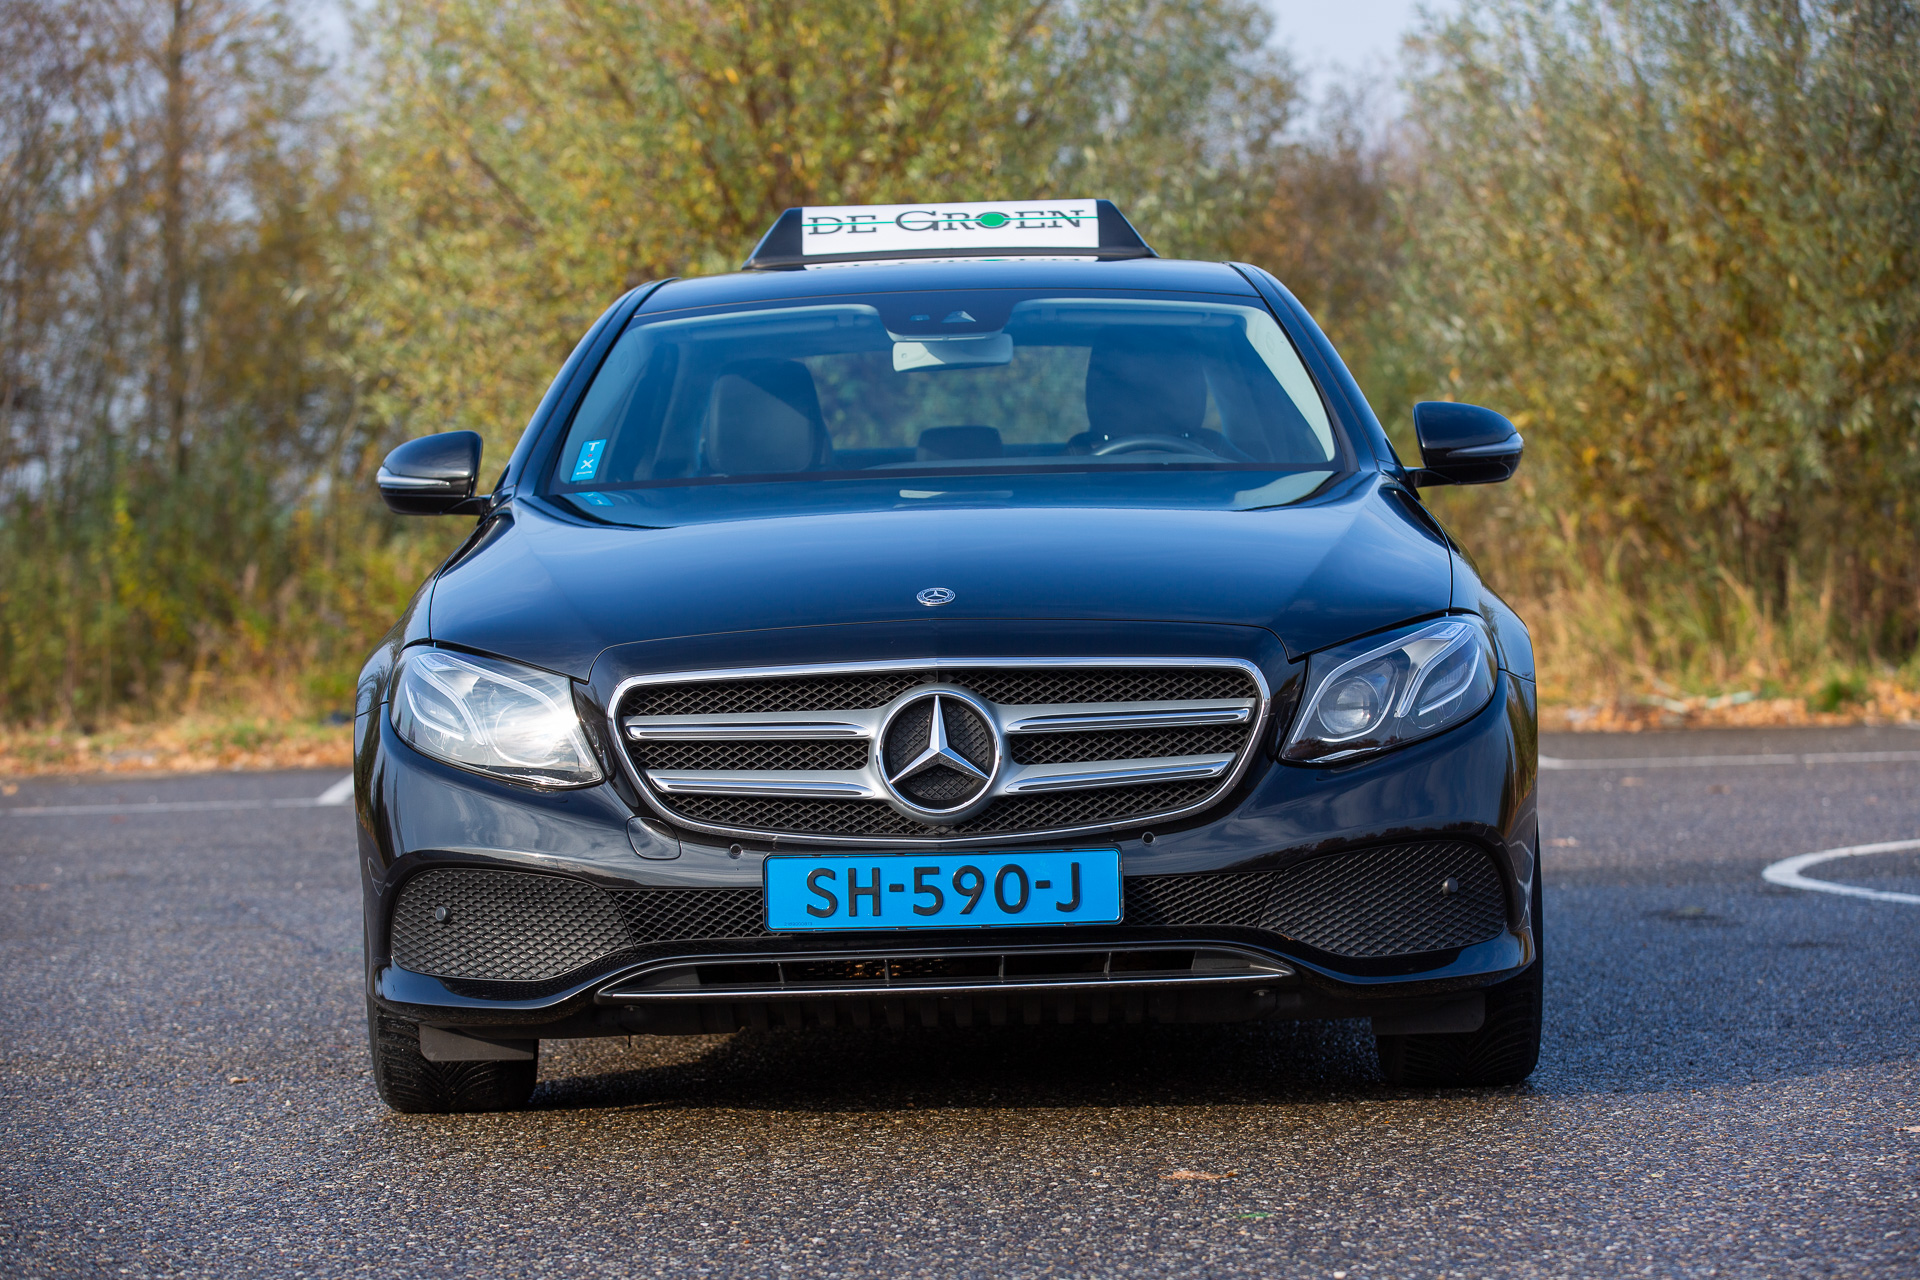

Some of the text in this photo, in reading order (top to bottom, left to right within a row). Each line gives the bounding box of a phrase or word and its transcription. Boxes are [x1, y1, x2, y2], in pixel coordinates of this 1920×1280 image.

[808, 210, 1085, 235] DE GROEN
[806, 862, 1080, 918] SH-590-J
